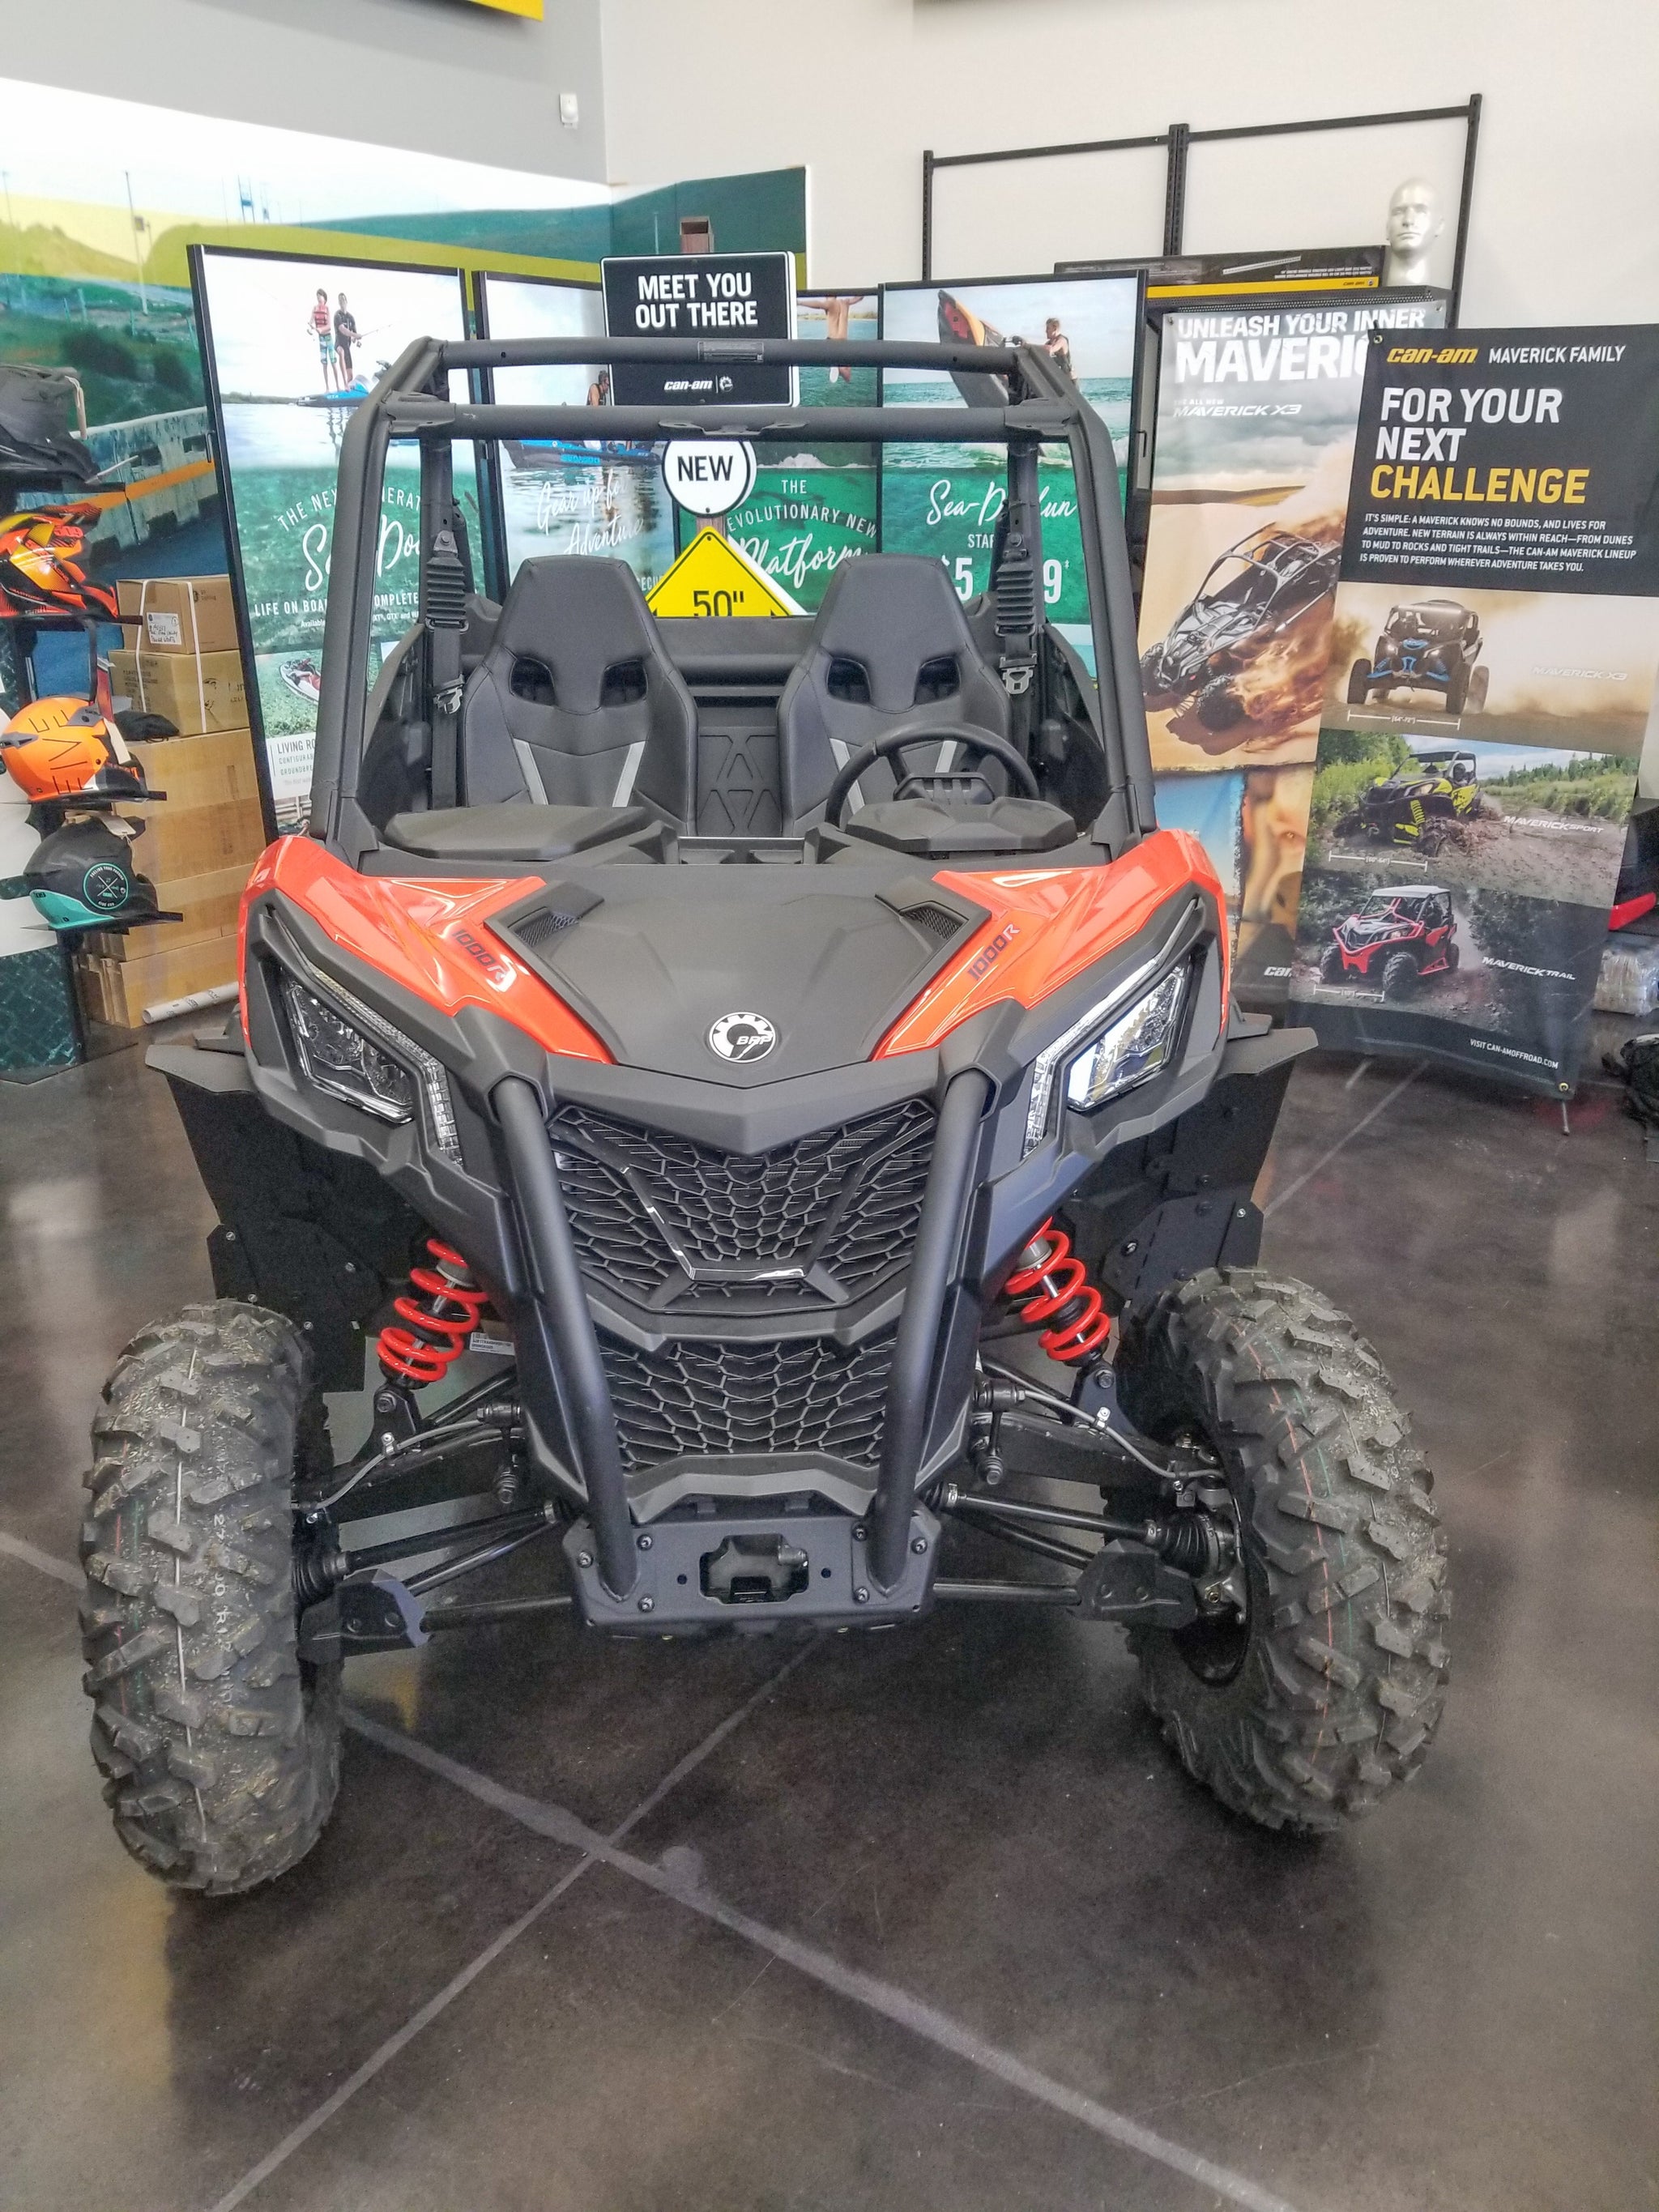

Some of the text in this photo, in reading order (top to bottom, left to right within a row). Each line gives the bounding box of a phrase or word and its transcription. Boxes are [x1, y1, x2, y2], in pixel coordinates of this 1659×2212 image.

[638, 272, 751, 300] MEET YOU
[635, 300, 758, 329] OUT THERE
[1179, 308, 1427, 339] UNLEASH YOUR INNER
[1387, 345, 1626, 364] can-am MAVERICK FAMILY
[663, 379, 713, 391] can-am
[1173, 403, 1303, 417] MAVERICK X3
[1380, 387, 1563, 424] FOR YOUR
[1375, 426, 1466, 462] NEXT
[678, 455, 733, 482] NEW
[781, 479, 807, 494] THE
[1371, 465, 1589, 505] CHALLENGE
[277, 501, 308, 532] THE
[536, 481, 578, 535] Gear
[583, 481, 602, 518] up
[846, 514, 877, 538] NEW
[1365, 514, 1606, 531] IT'S SIMPLE: A MAVERICK KNOWS NO BOUNDS, AND LIVES FOR
[1363, 527, 1410, 536] ADVENTURE.
[1412, 529, 1431, 538] NEW
[1432, 530, 1465, 539] TERRAIN
[1467, 531, 1474, 539] IS
[1476, 531, 1507, 541] ALWAYS
[1508, 532, 1537, 542] WITHIN
[1603, 535, 1633, 545] DUNES
[1362, 540, 1371, 548] TO
[1372, 540, 1390, 549] MUD
[1392, 542, 1401, 550] TO
[1402, 542, 1429, 551] ROCKS
[1430, 543, 1447, 552] AND
[1448, 543, 1472, 553] TIGHT
[1526, 547, 1559, 556] CAN-AM
[1559, 548, 1603, 559] MAVERICK
[1604, 549, 1636, 560] LINEUP
[1360, 553, 1584, 572] IS PROVEN TO PERFORM WHEREVER ADVENTURE TAKES YOU.
[254, 603, 282, 617] LIFE
[284, 601, 298, 613] ON
[693, 590, 744, 616] 50"
[1531, 667, 1628, 680] MAVERICK X3
[277, 739, 304, 754] LIVING
[1503, 815, 1604, 833] MAVERICK SPORT
[967, 923, 1021, 982] 1000R
[1482, 957, 1577, 980] MAVERICK TRAIL
[736, 1036, 772, 1046] BRP
[1470, 1039, 1559, 1069] VISIT CAN-AMOFFROAD.COM
